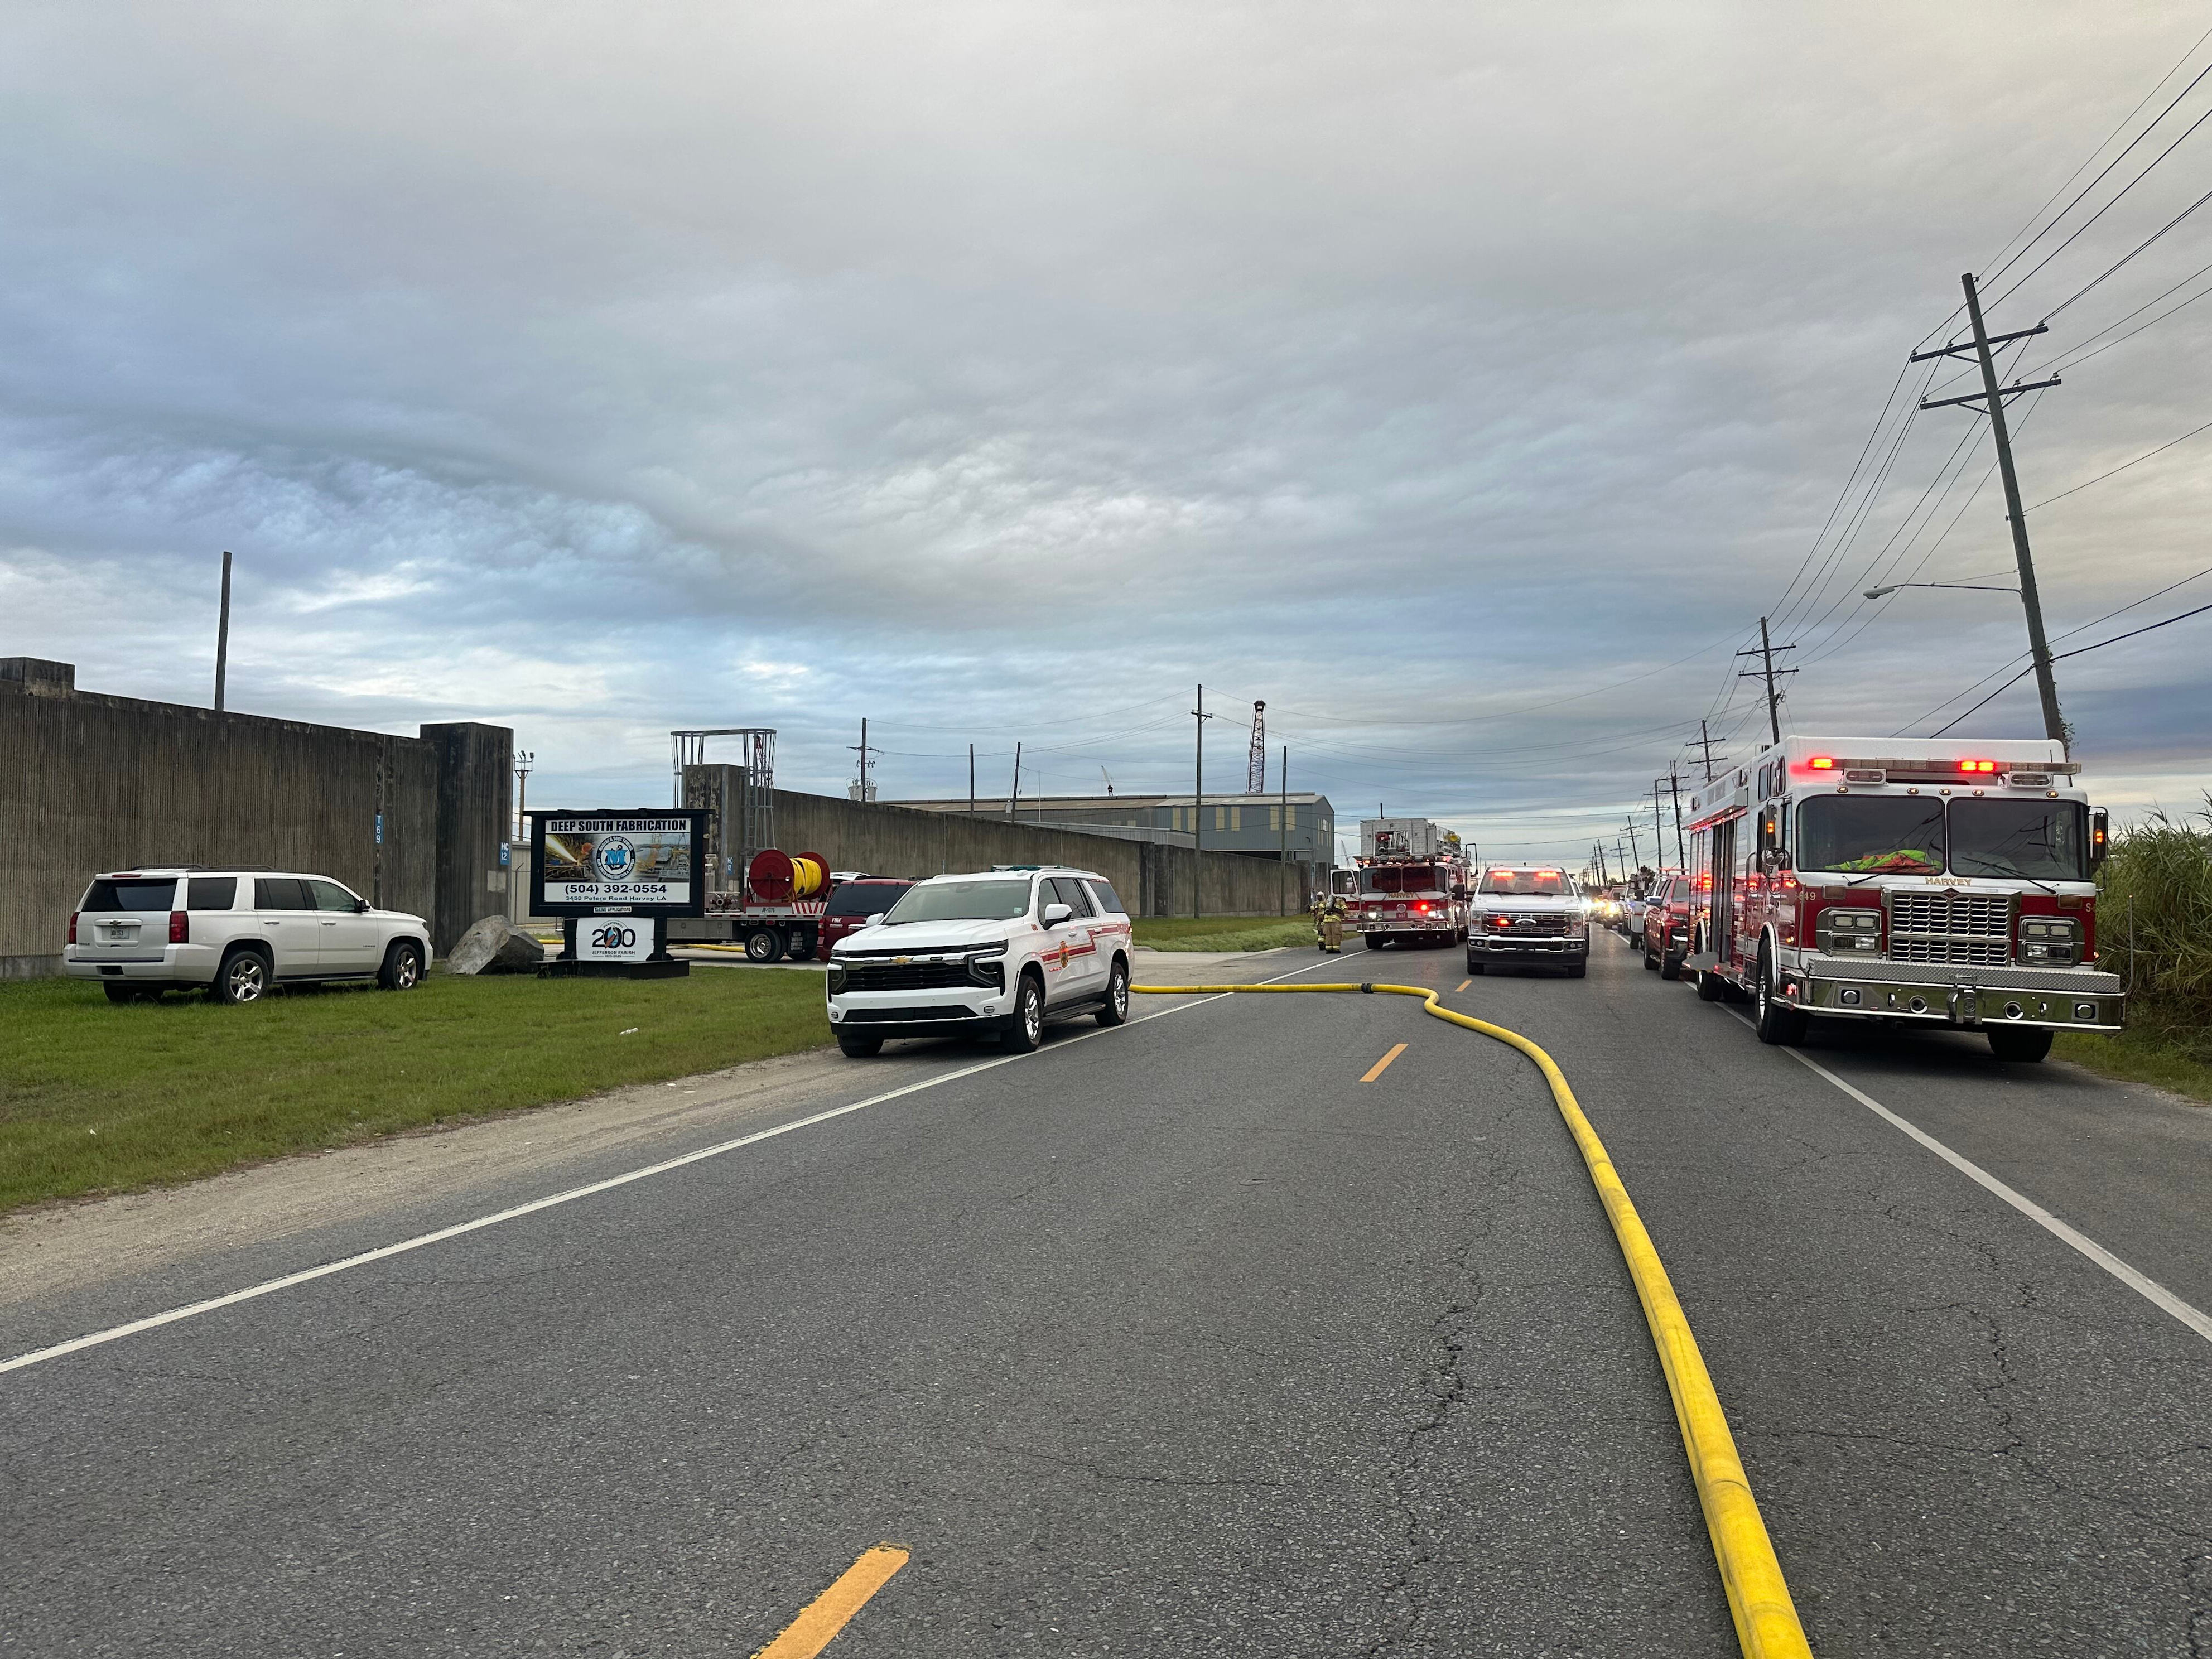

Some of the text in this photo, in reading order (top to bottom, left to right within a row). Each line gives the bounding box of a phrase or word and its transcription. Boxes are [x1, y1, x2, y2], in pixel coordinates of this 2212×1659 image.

[551, 819, 686, 831] DEEP SOUTH FABRICATION
[501, 842, 509, 851] HC
[1925, 877, 1972, 886] HARVEY
[565, 885, 667, 894] (504) 392-0554
[592, 926, 636, 948] 200
